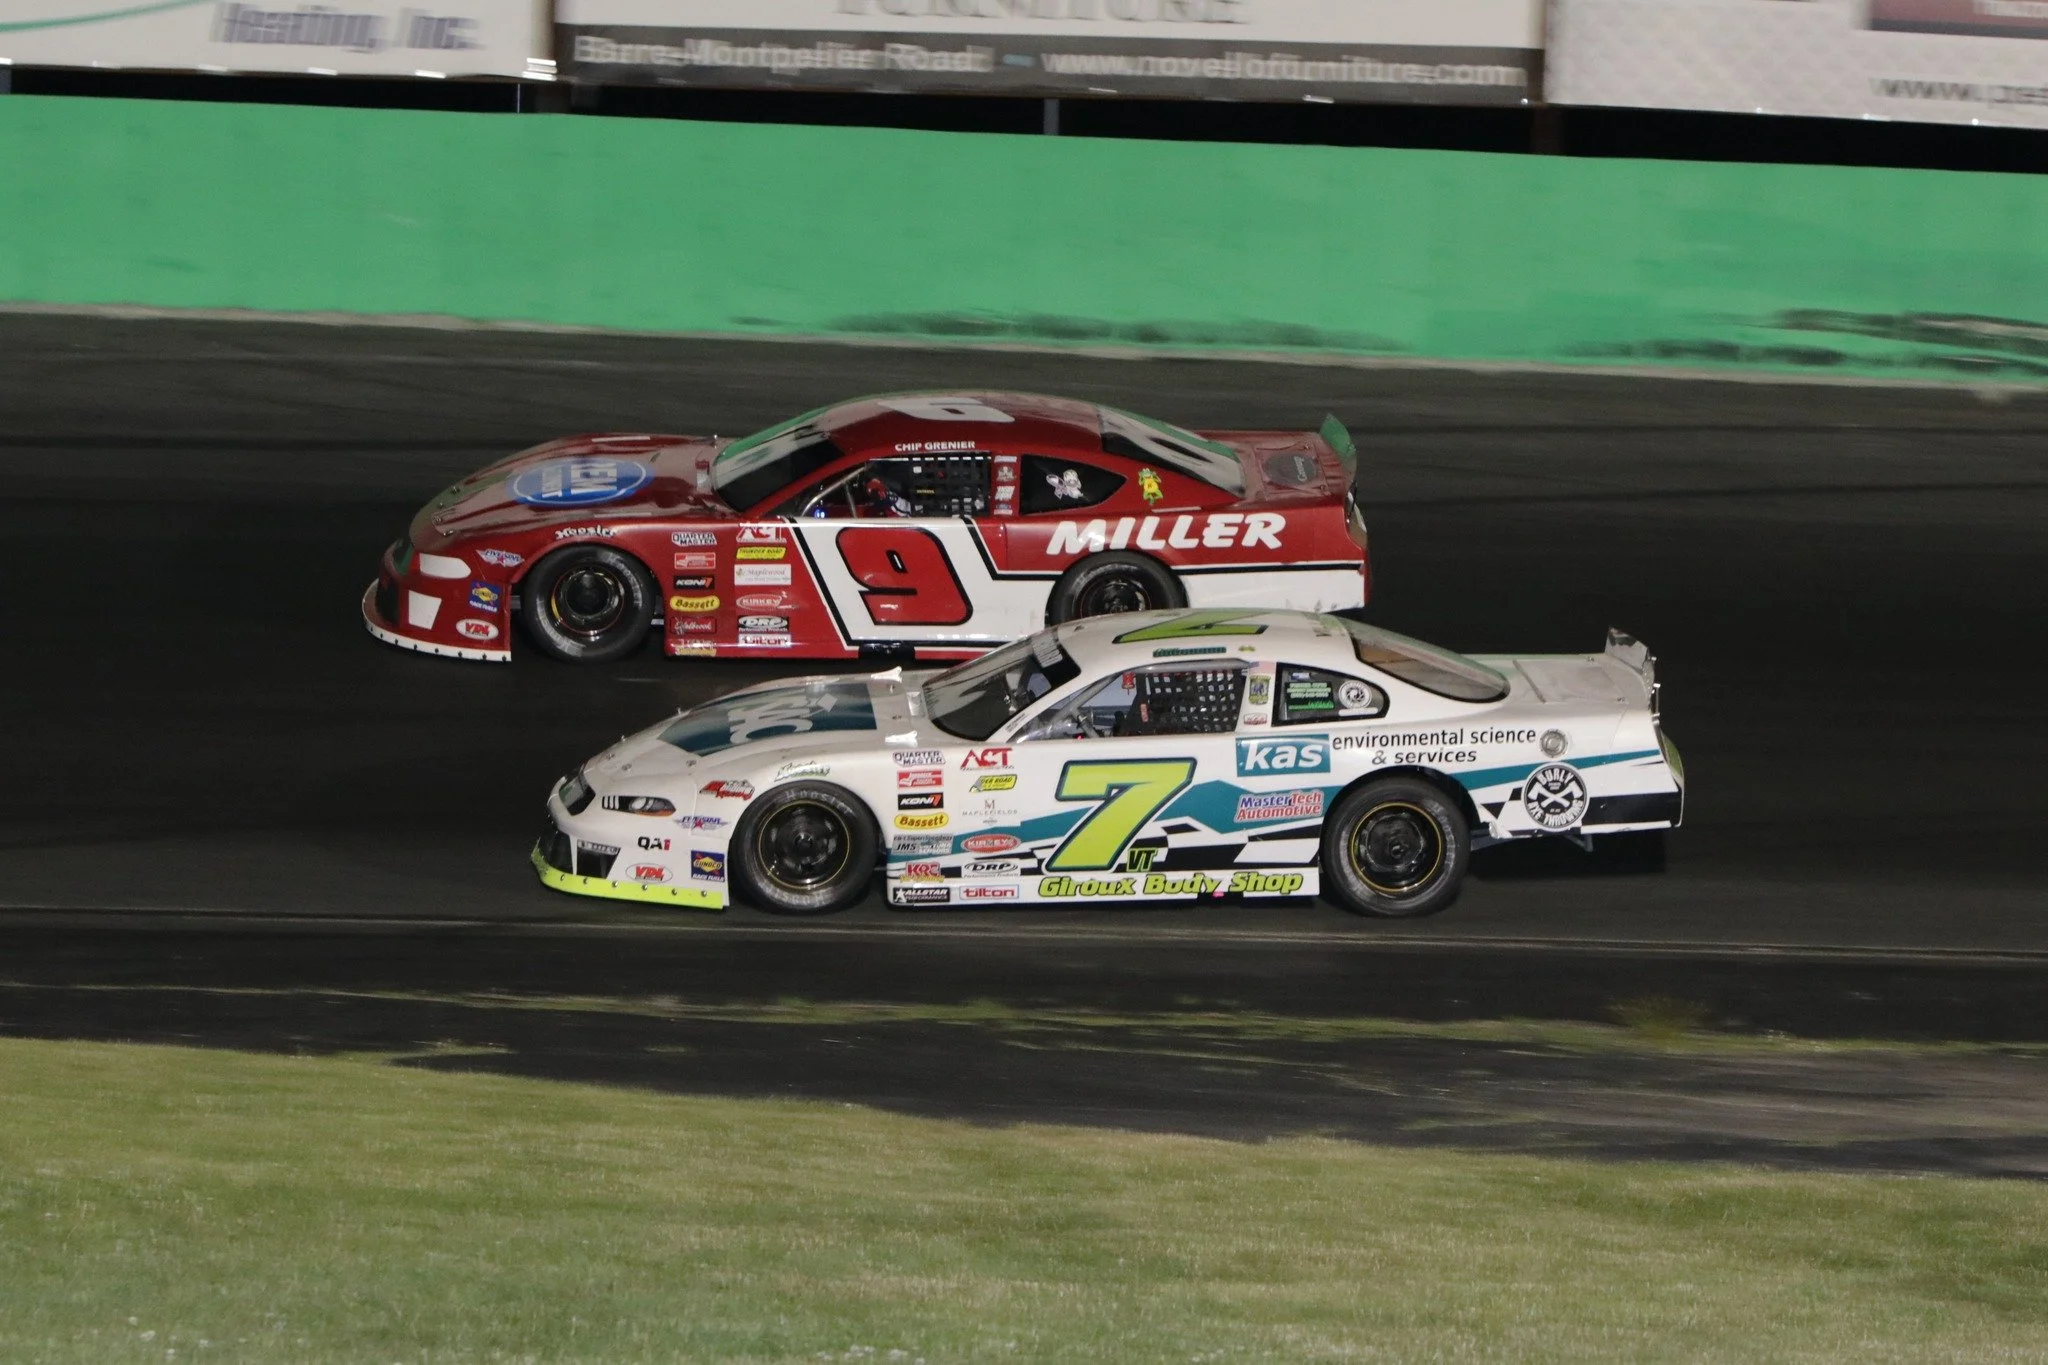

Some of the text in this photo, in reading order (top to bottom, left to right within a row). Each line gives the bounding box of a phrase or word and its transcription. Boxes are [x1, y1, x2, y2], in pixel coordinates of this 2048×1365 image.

[895, 441, 975, 451] CHIP GRENIER
[673, 533, 714, 542] QUARTER
[1046, 513, 1287, 555] MILLER
[676, 577, 710, 587] KONI
[835, 527, 974, 626] 9
[675, 599, 715, 609] Bassett
[1332, 728, 1536, 750] environmental science
[894, 751, 940, 761] QUARTER
[903, 757, 943, 765] MASTER
[960, 748, 1012, 767] ACT
[1245, 741, 1323, 771] kas
[1372, 749, 1477, 765] & services
[1536, 768, 1574, 786] BURLY
[900, 796, 938, 806] KONI
[962, 809, 1018, 817] MAPLEFIELDS
[1046, 757, 1197, 871] 7
[1237, 804, 1322, 821] Automotive
[899, 814, 944, 827] Bassett
[637, 836, 671, 850] QA1
[695, 860, 721, 869] SUNOCO
[972, 862, 1011, 871] DRP
[1127, 849, 1156, 871] VT
[907, 863, 939, 876] KRC
[1038, 872, 1303, 897] Giroux Body Shop
[963, 888, 1015, 897] tilton
